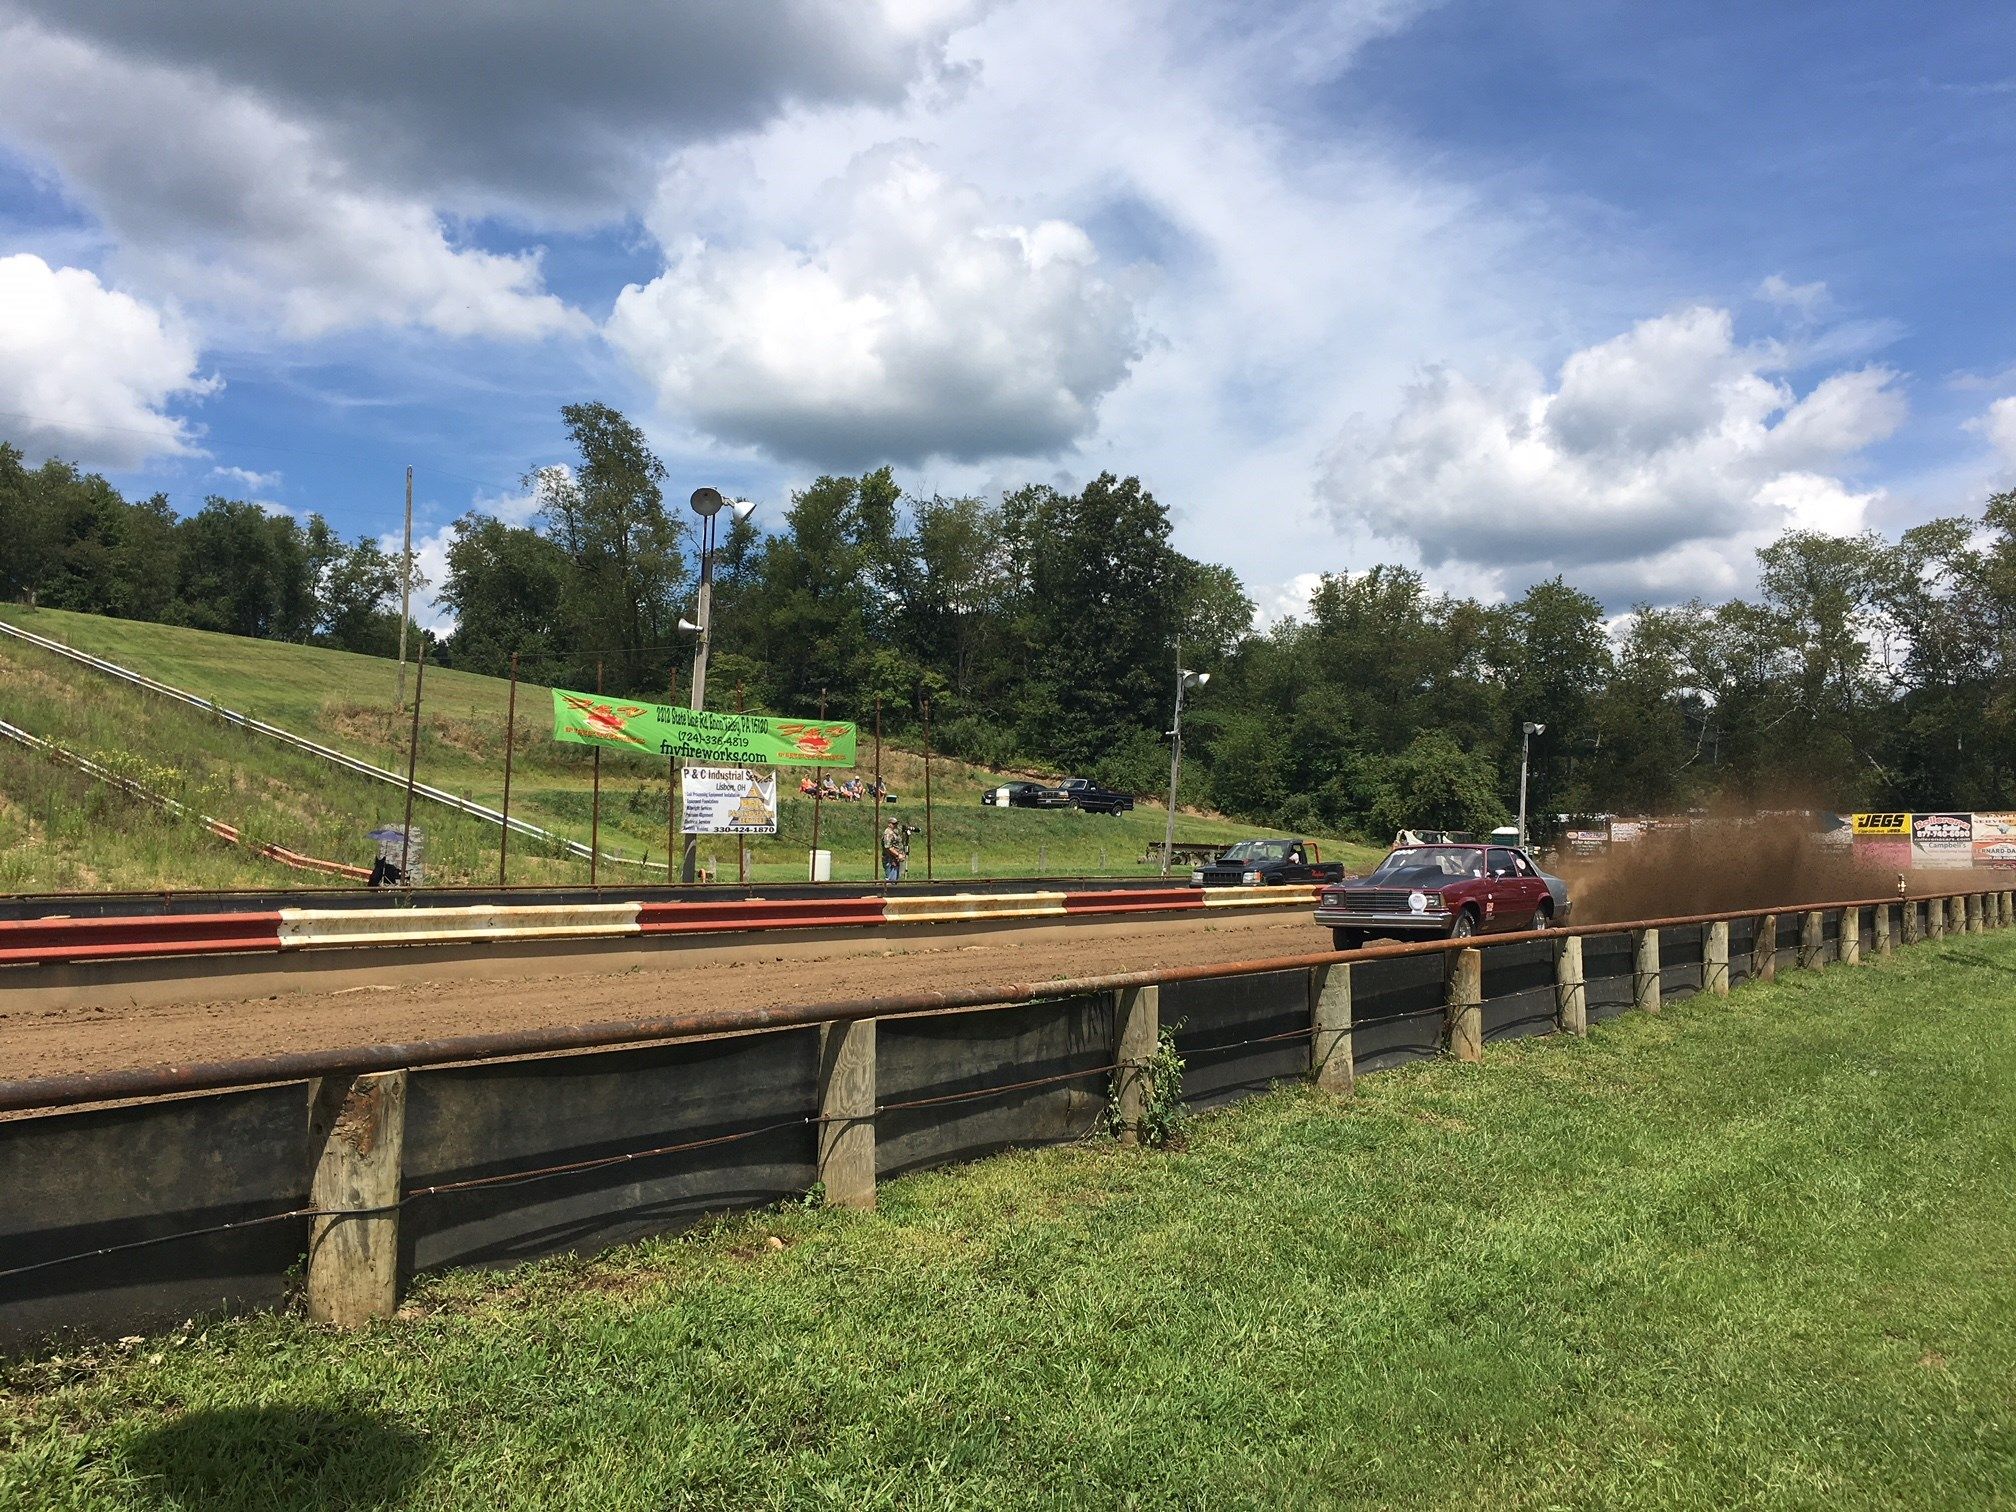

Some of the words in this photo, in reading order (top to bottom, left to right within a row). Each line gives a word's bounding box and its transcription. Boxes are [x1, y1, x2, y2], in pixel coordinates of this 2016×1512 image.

[672, 707, 687, 726] State
[741, 716, 751, 733] PA
[678, 730, 749, 747] (724)-336-4819
[660, 738, 768, 763] fnvfireworks.com
[683, 768, 690, 779] P
[691, 769, 699, 780] &
[700, 769, 707, 780] C
[708, 769, 744, 781] Industrial
[715, 783, 736, 792] Lisbon,
[737, 783, 746, 792] OH
[1858, 815, 1905, 828] JEGS
[1928, 841, 1967, 849] Campbell's
